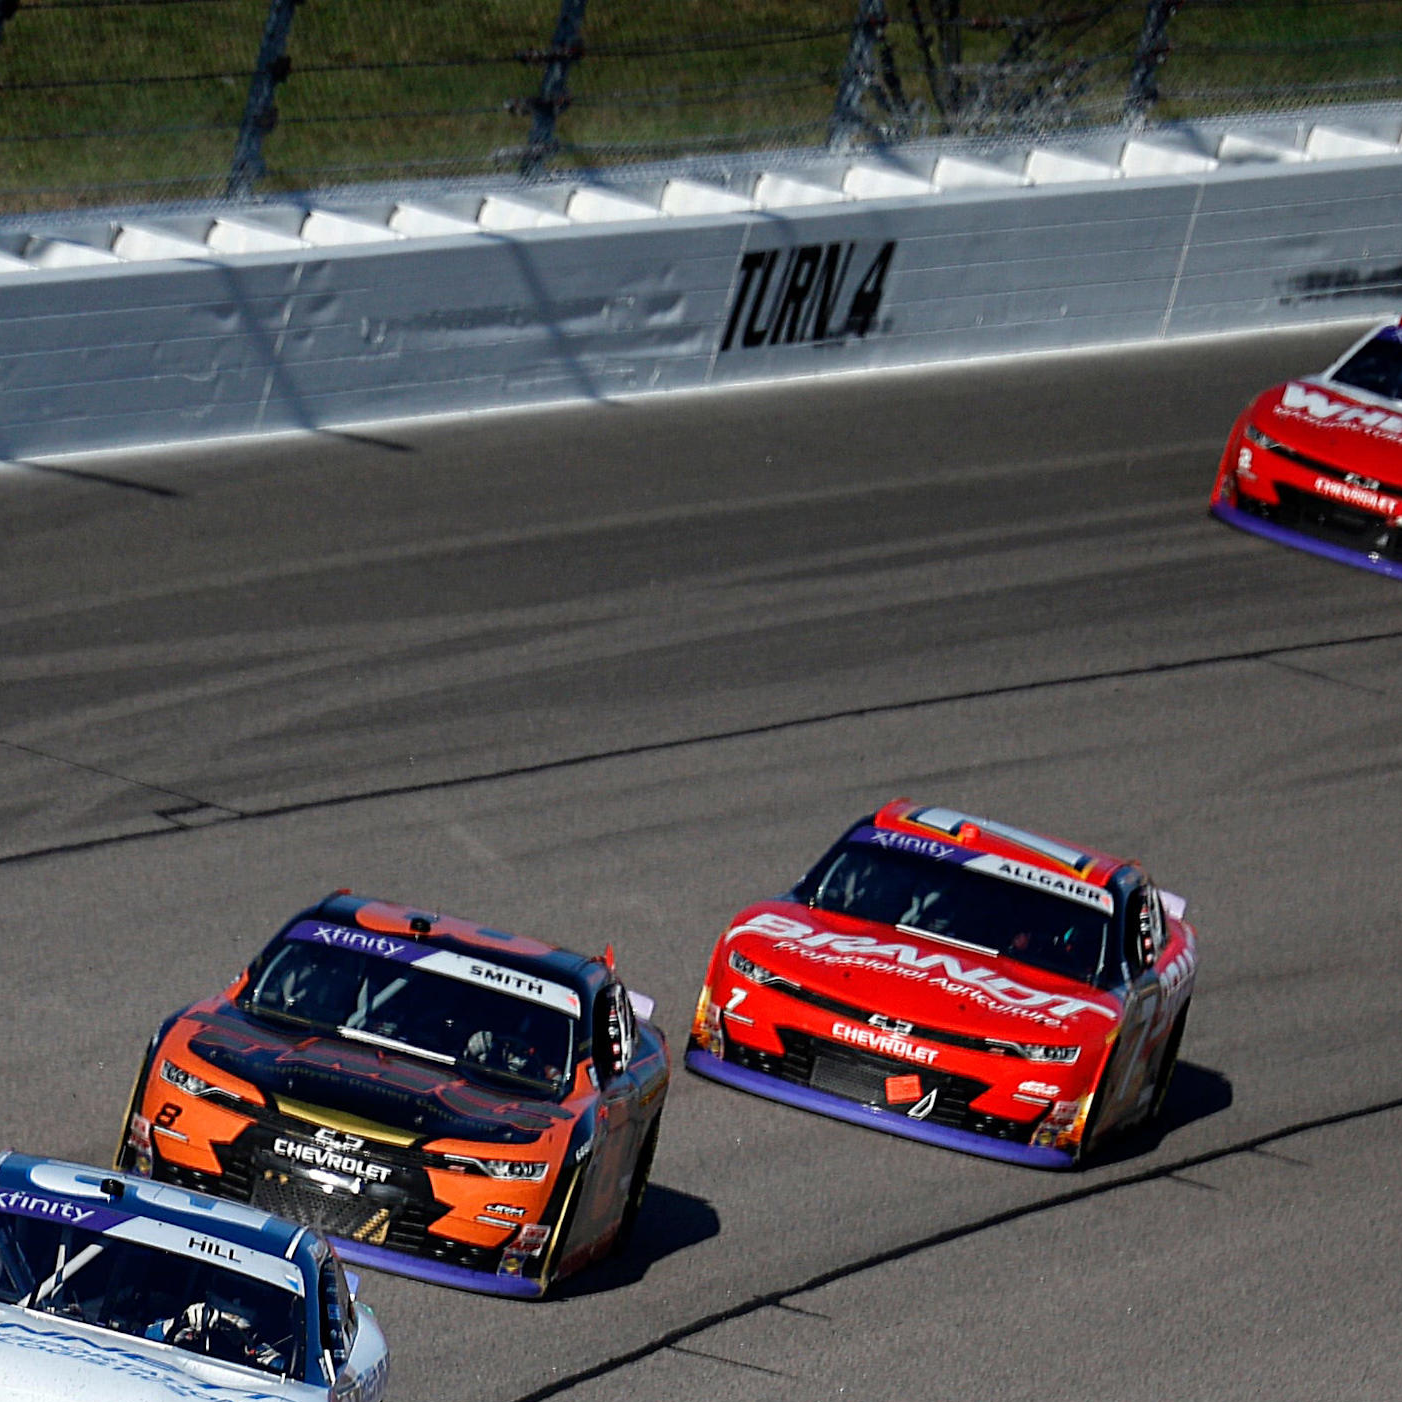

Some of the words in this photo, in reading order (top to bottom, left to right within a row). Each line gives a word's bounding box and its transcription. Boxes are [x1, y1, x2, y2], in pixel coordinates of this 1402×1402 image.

[719, 241, 854, 351] TURN
[847, 240, 898, 338] 4
[870, 830, 956, 861] xfinity
[998, 861, 1101, 902] ALLGAIER
[313, 925, 405, 958] xfinity
[772, 940, 930, 983] Professional
[469, 964, 544, 995] SMITH
[724, 913, 1118, 1019] BRANDT
[832, 1021, 940, 1065] CHEVROLET
[155, 1101, 183, 1127] 8
[273, 1136, 393, 1183] CHEVROLET
[188, 1236, 242, 1264] HILL
